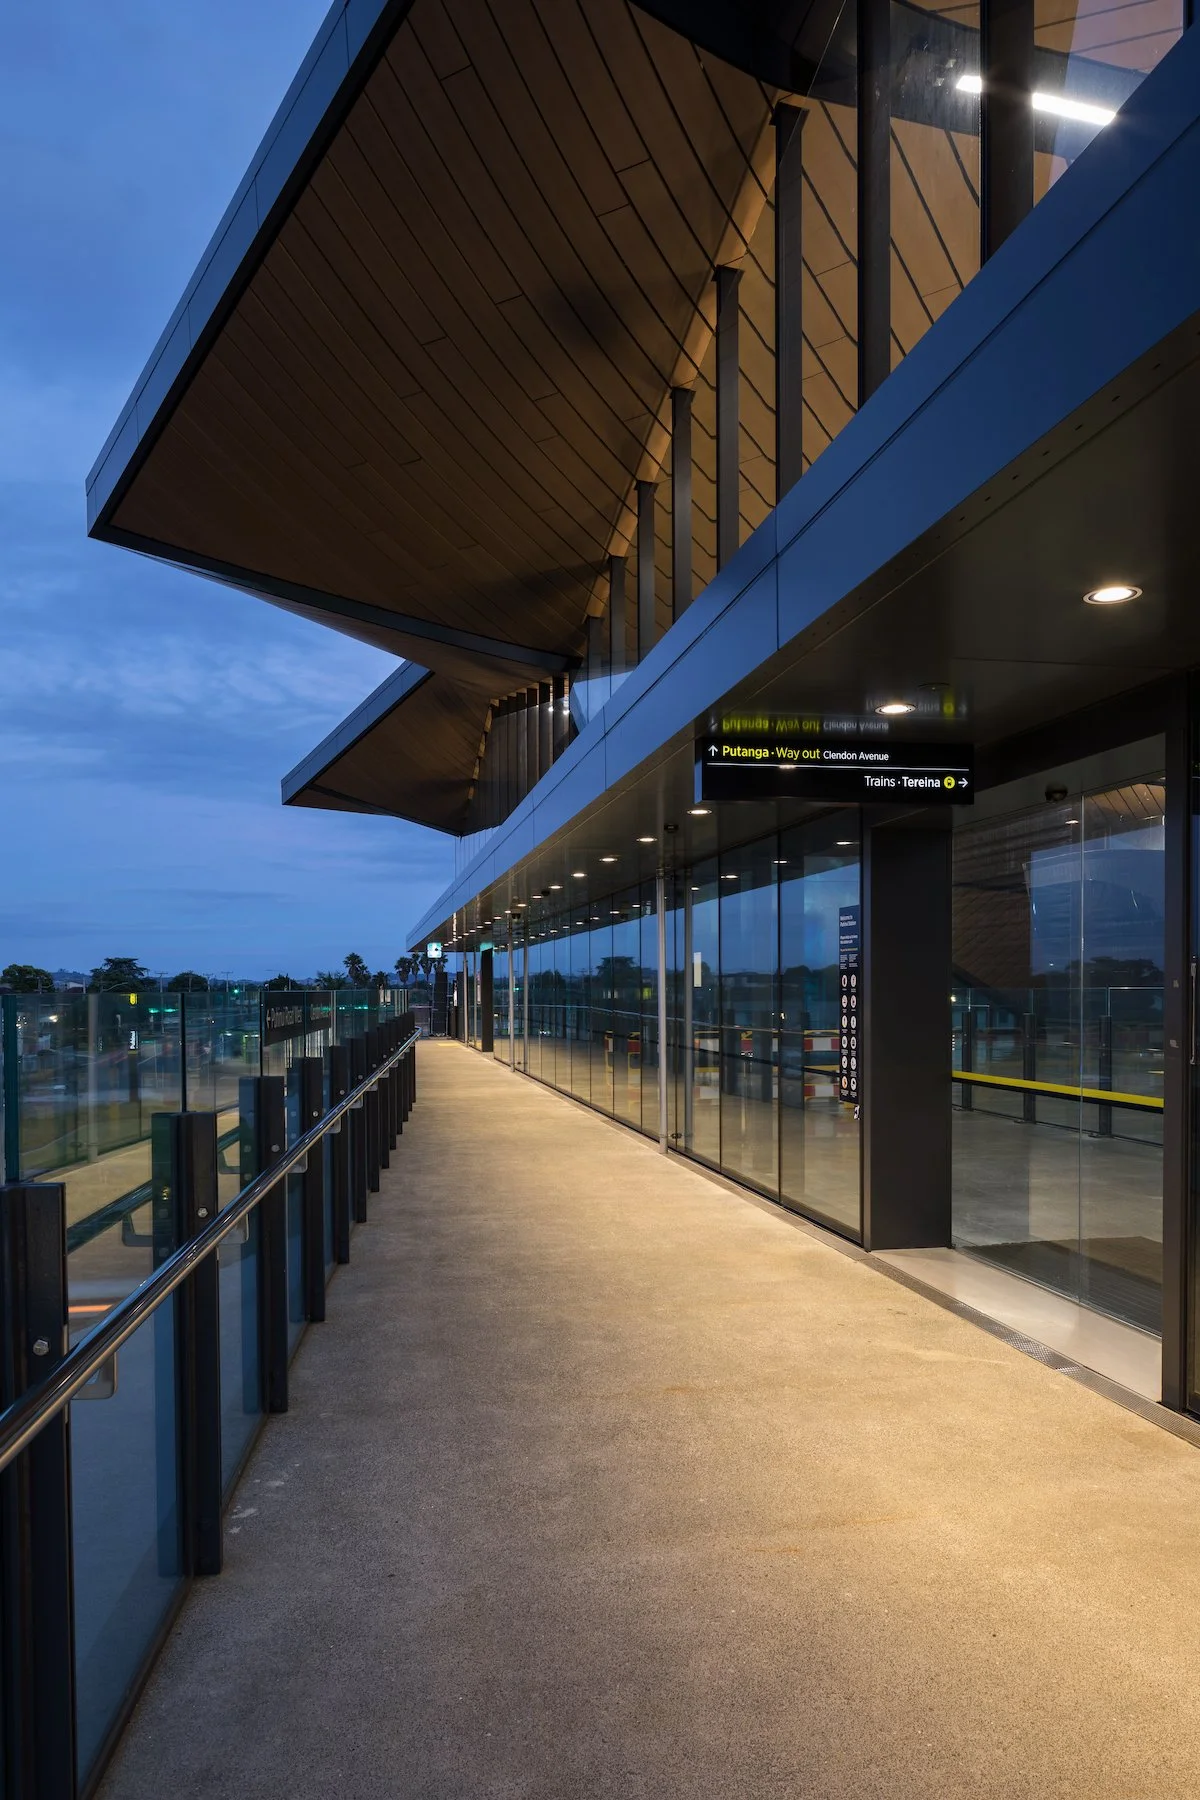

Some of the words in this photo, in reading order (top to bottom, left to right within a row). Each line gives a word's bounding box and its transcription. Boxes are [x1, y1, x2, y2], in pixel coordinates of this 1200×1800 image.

[722, 745, 769, 759] Putanga
[775, 747, 800, 760] Way
[802, 748, 821, 759] out
[823, 750, 857, 760] Clendon
[858, 751, 889, 761] Avenue
[864, 775, 896, 787] Trains
[901, 776, 941, 788] Tereina
